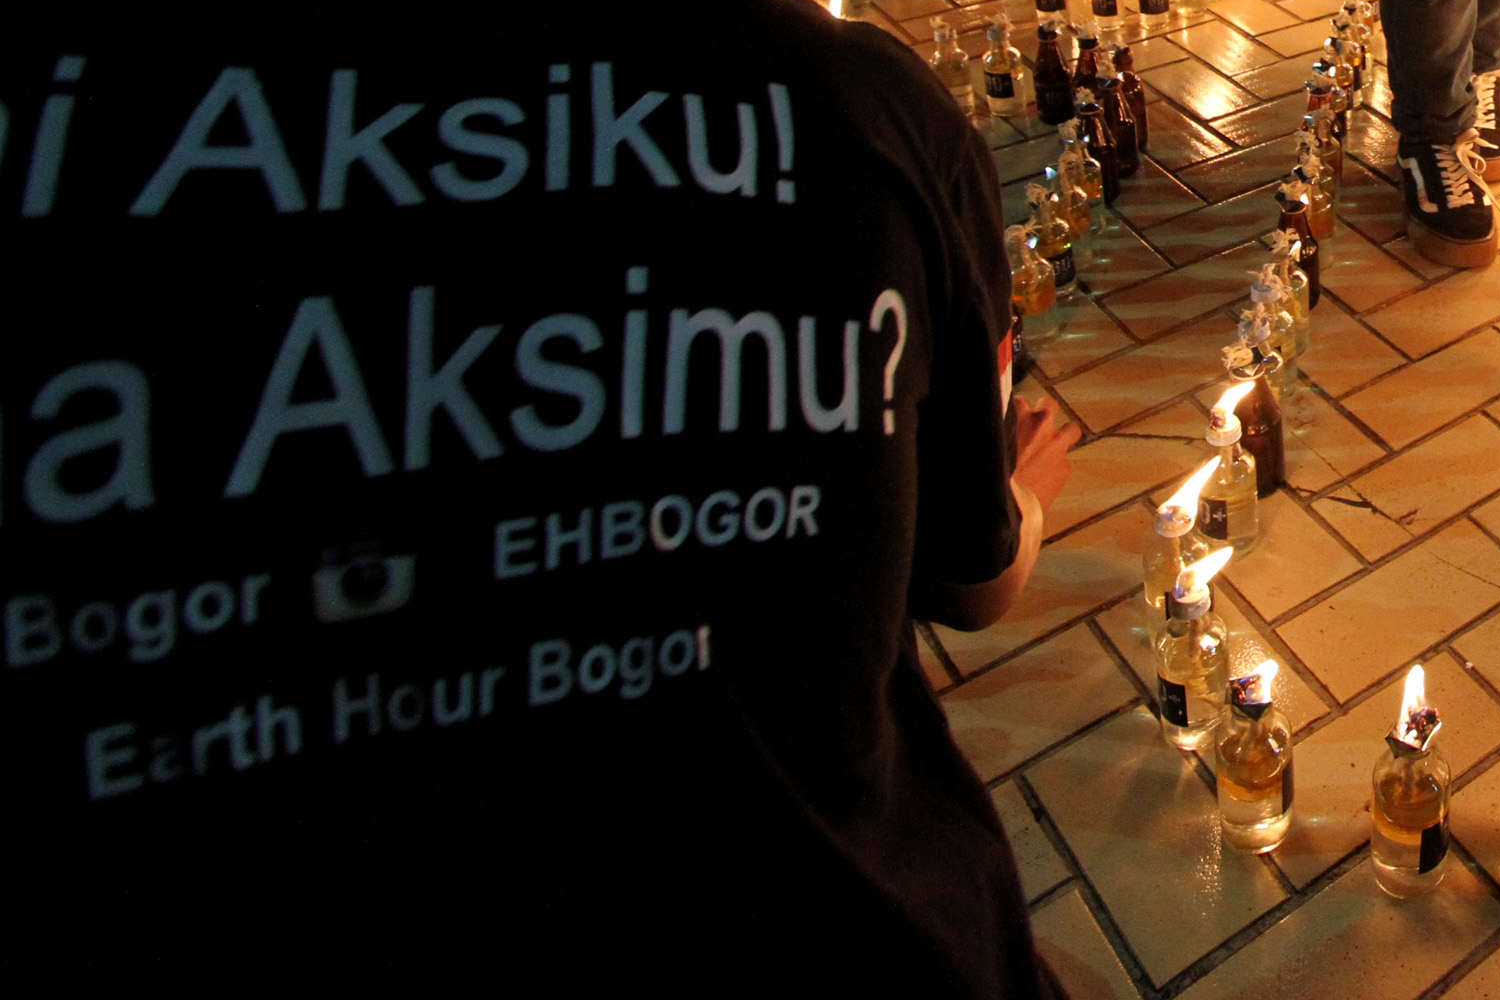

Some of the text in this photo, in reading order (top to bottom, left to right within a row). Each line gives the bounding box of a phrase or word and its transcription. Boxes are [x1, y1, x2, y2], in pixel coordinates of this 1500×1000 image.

[0, 55, 798, 218] i Aksiku!
[223, 265, 908, 500] Aksimu?
[492, 483, 823, 580] EHBOGOR
[84, 694, 304, 800] Earth
[331, 668, 505, 745] Hour
